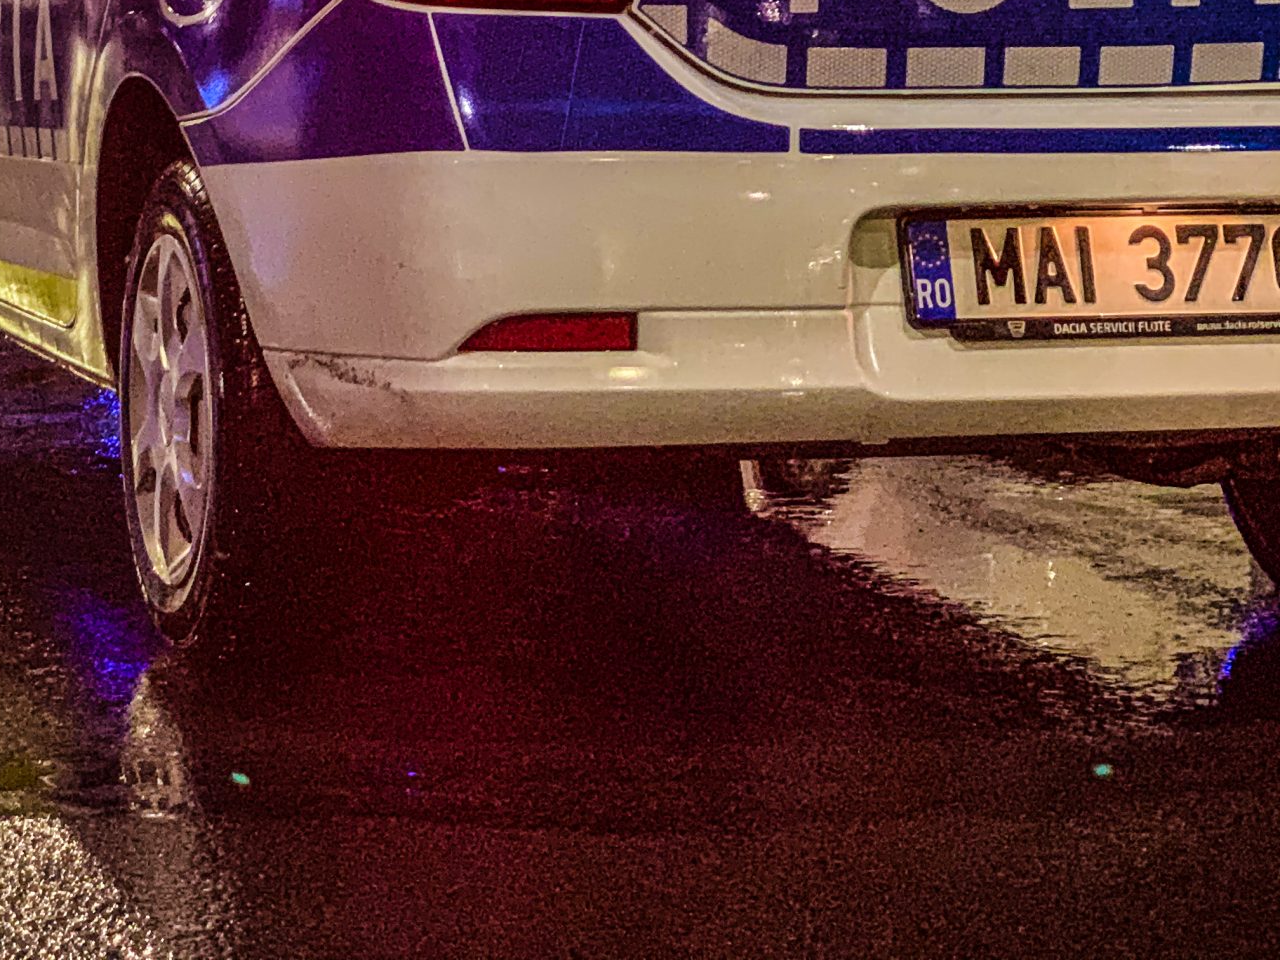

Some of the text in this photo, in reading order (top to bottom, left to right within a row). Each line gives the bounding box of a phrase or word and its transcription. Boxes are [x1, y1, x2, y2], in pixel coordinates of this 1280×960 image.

[970, 224, 1280, 305] MAI 377
[916, 278, 952, 309] RO
[1053, 323, 1088, 335] DACIA
[1089, 322, 1136, 334] SERVICII
[1138, 320, 1172, 333] FLOTE
